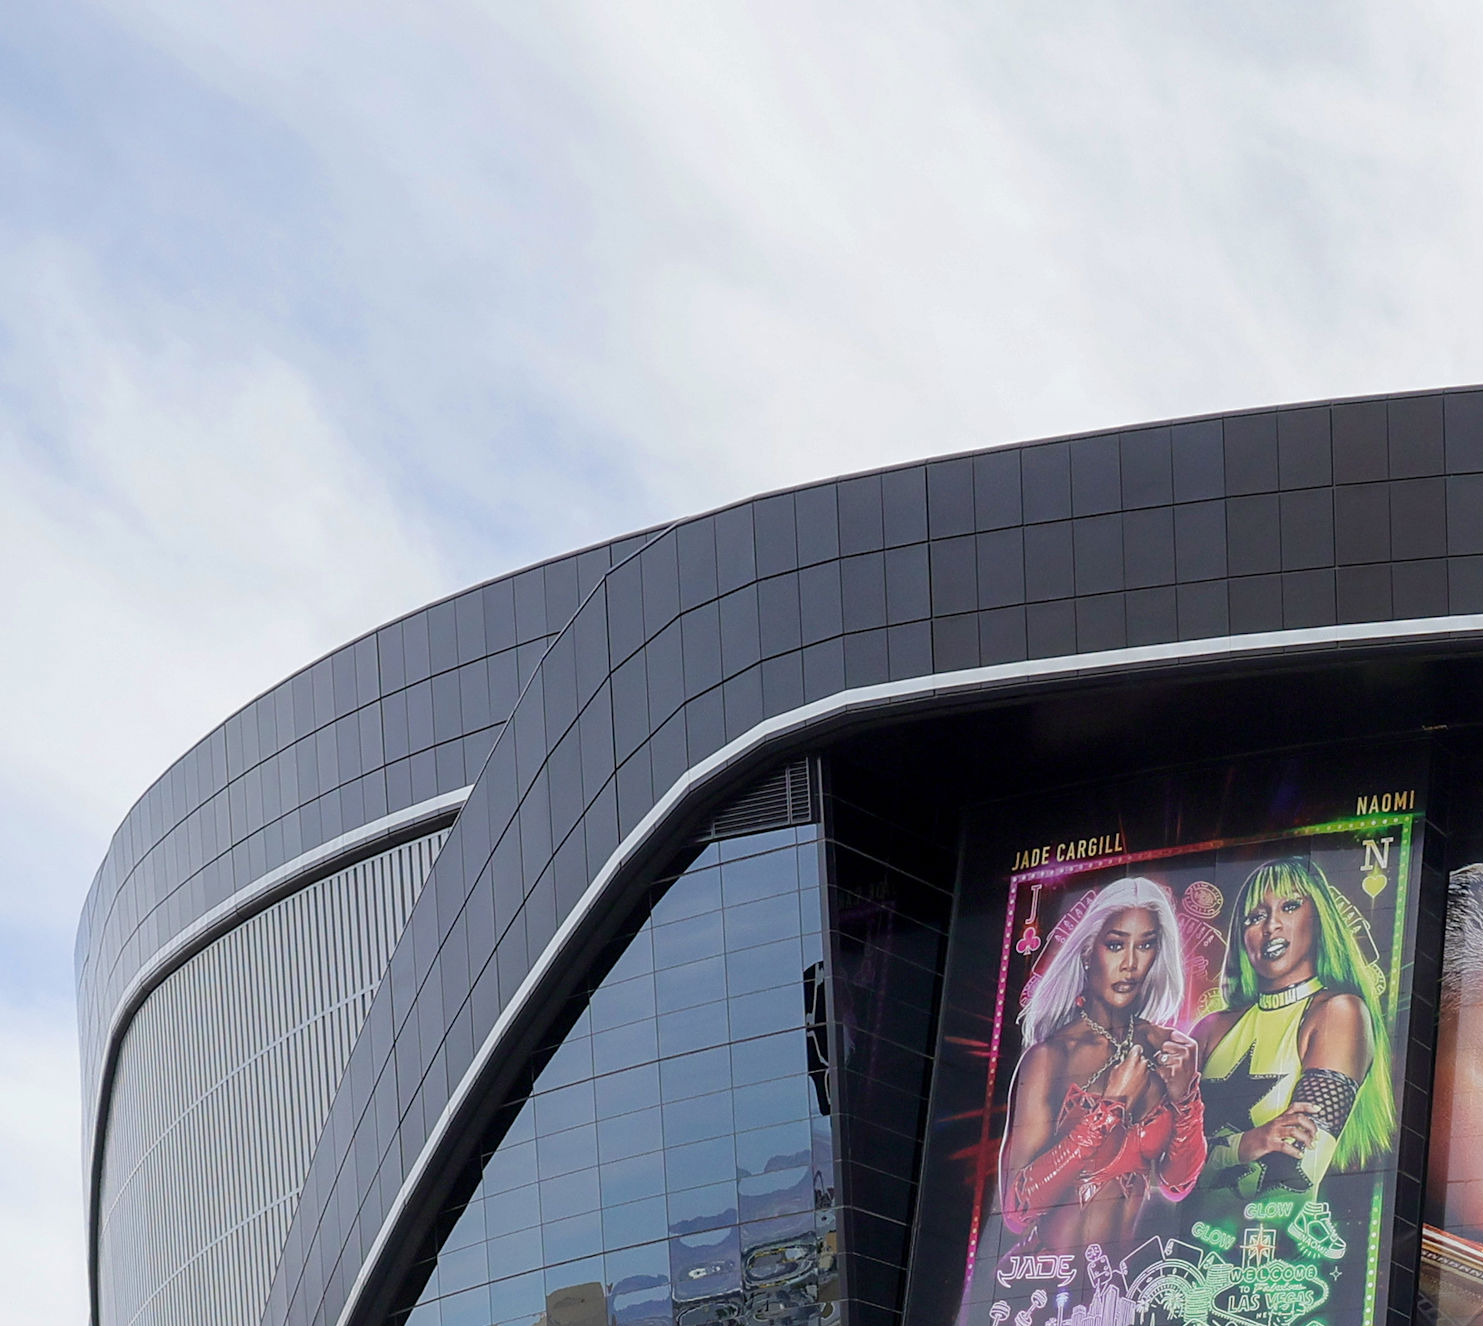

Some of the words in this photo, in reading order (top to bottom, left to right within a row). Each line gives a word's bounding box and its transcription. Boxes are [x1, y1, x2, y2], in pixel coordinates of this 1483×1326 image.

[1356, 790, 1416, 816] NAOMI
[1011, 844, 1050, 872] JADE
[1056, 832, 1123, 862] CARGILL
[1359, 837, 1394, 872] N
[1025, 884, 1042, 924] J
[1244, 1201, 1294, 1219] GLOW
[1191, 1221, 1237, 1250] GLOW
[997, 1254, 1077, 1289] JADE
[1230, 1265, 1316, 1283] WELCOME
[1228, 1294, 1260, 1313] LAS
[1265, 1290, 1314, 1310] VEGAS
[1239, 1285, 1250, 1294] TO
